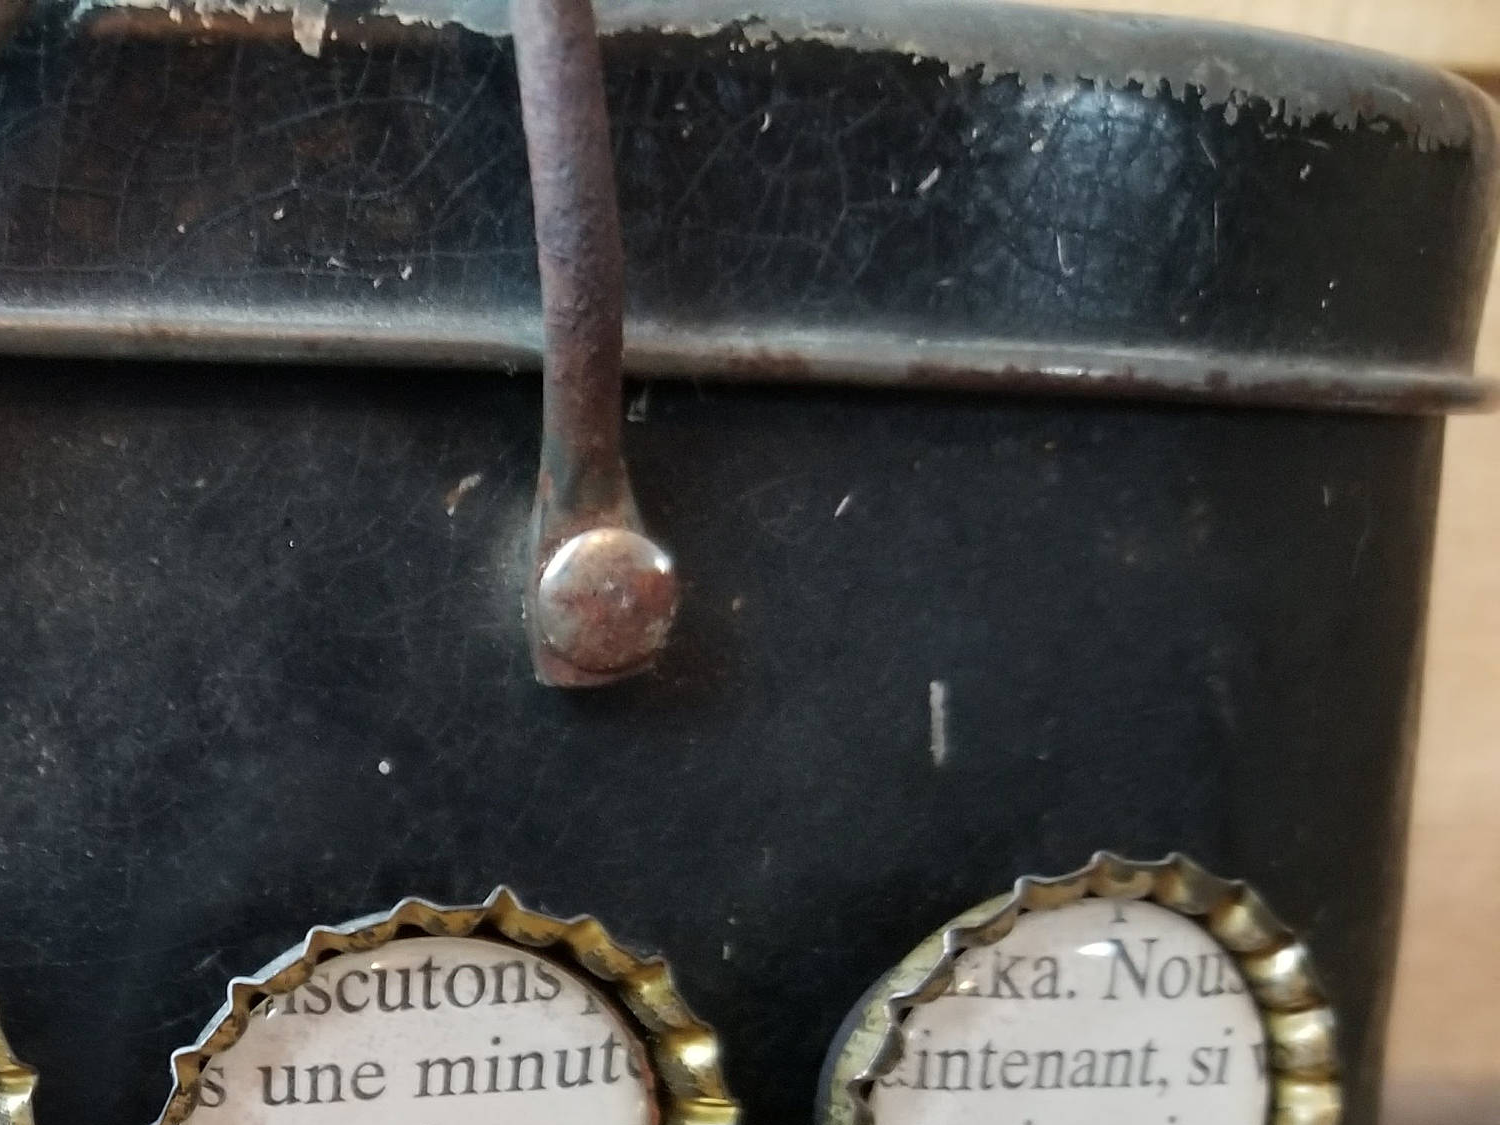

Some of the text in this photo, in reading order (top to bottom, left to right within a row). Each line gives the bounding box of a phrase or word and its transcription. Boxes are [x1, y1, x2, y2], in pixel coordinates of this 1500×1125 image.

[259, 1059, 386, 1107] une
[880, 1029, 1170, 1095] intenant,
[1187, 1027, 1234, 1087] si
